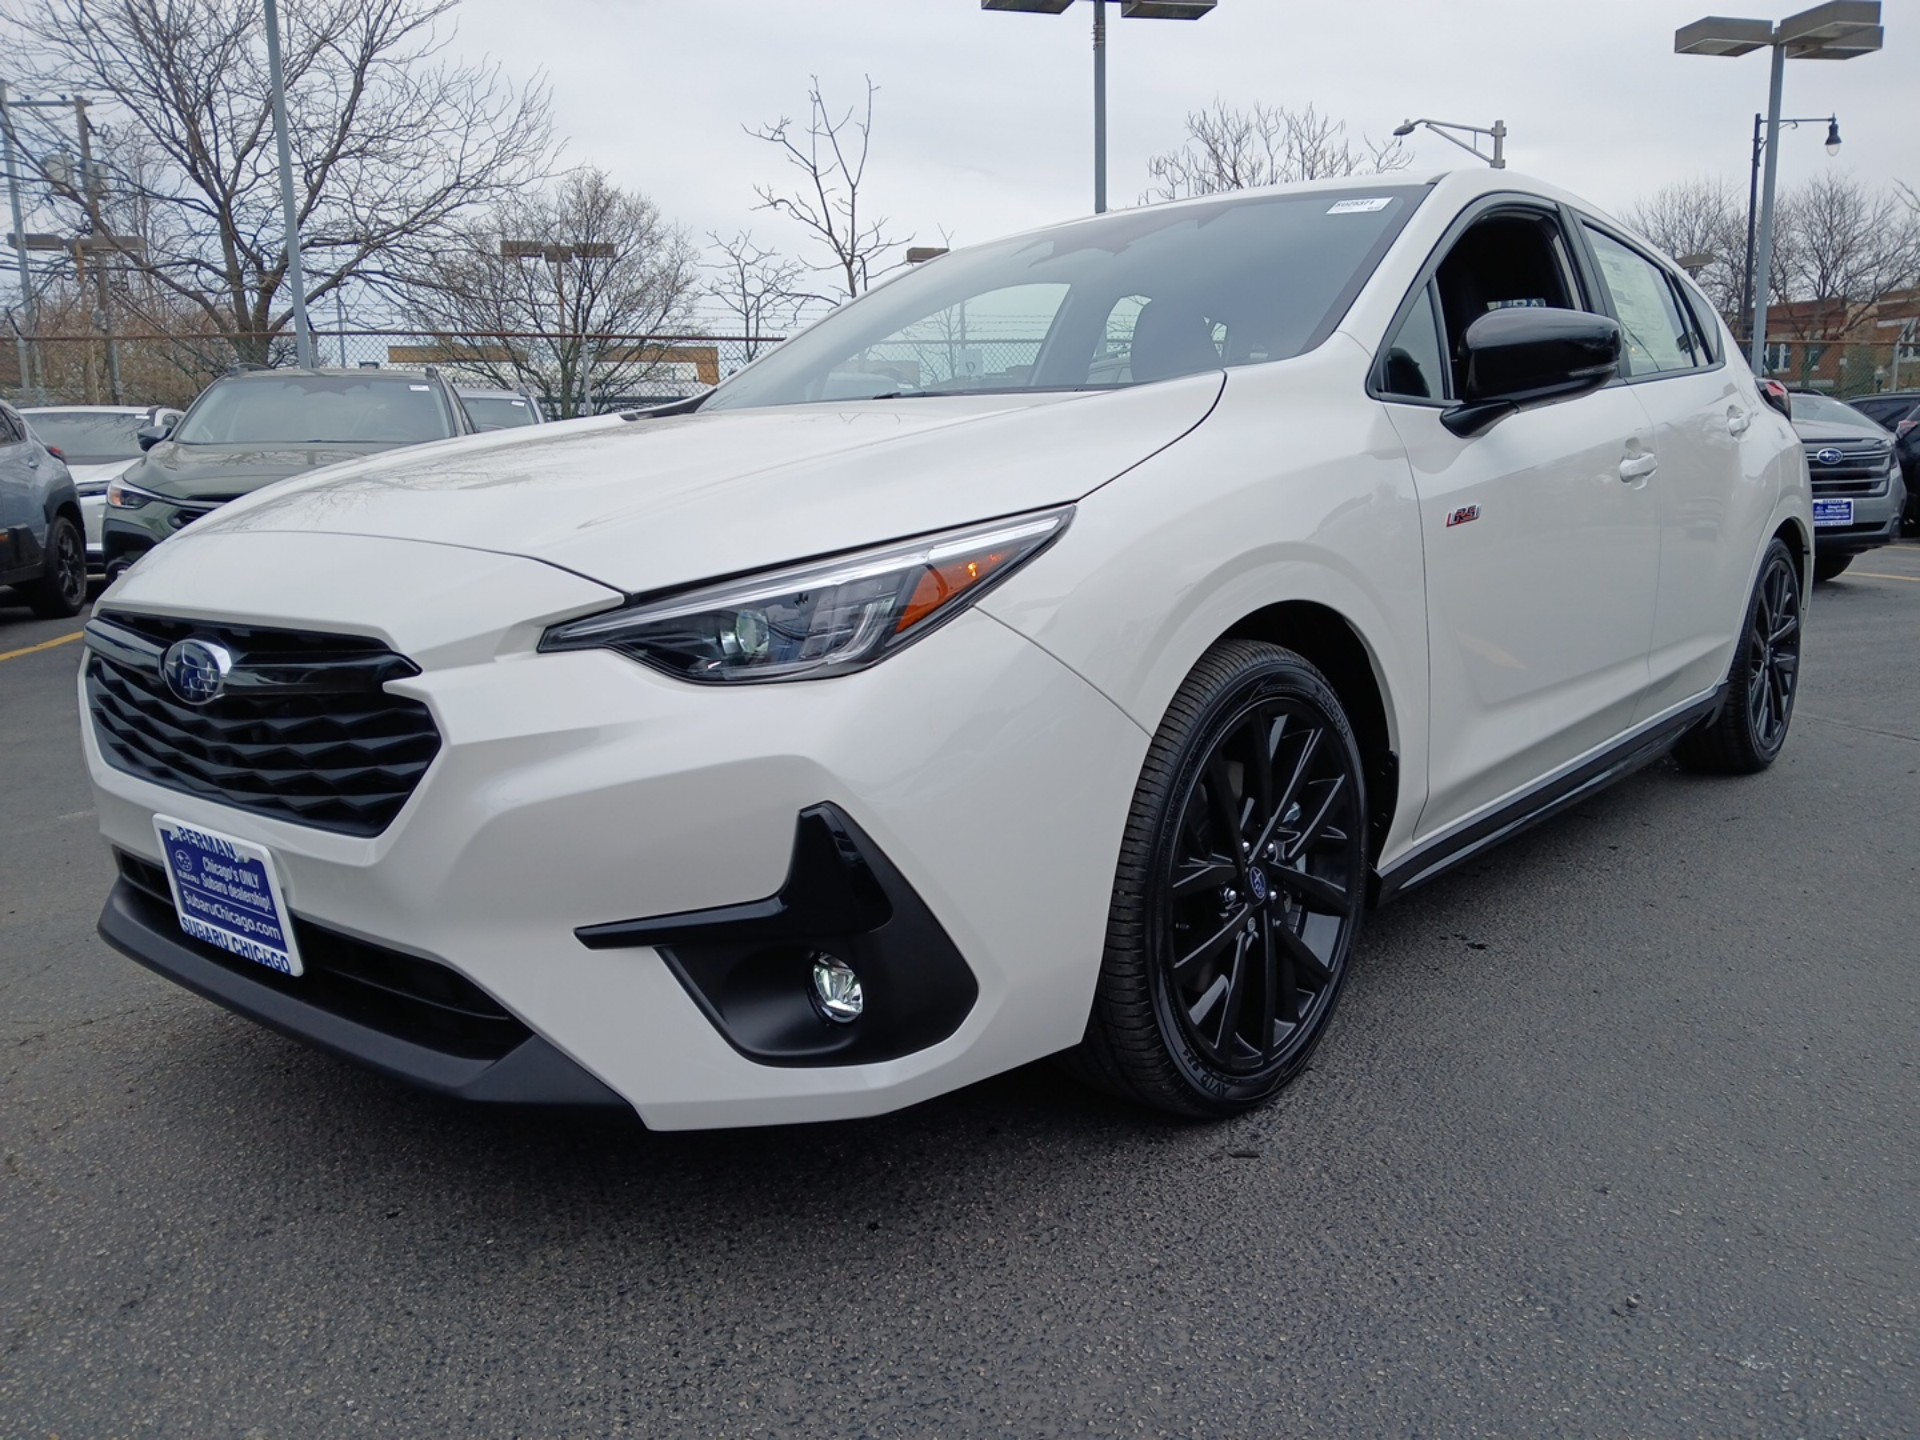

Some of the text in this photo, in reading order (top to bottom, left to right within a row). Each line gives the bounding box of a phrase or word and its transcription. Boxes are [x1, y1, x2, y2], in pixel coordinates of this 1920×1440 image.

[176, 826, 236, 859] BERMAN
[201, 872, 228, 896] Subaru
[202, 856, 260, 889] Chicago's ONLY
[183, 890, 281, 941] SubaruChicago.com
[181, 916, 292, 975] SUBARU CHICAGO
